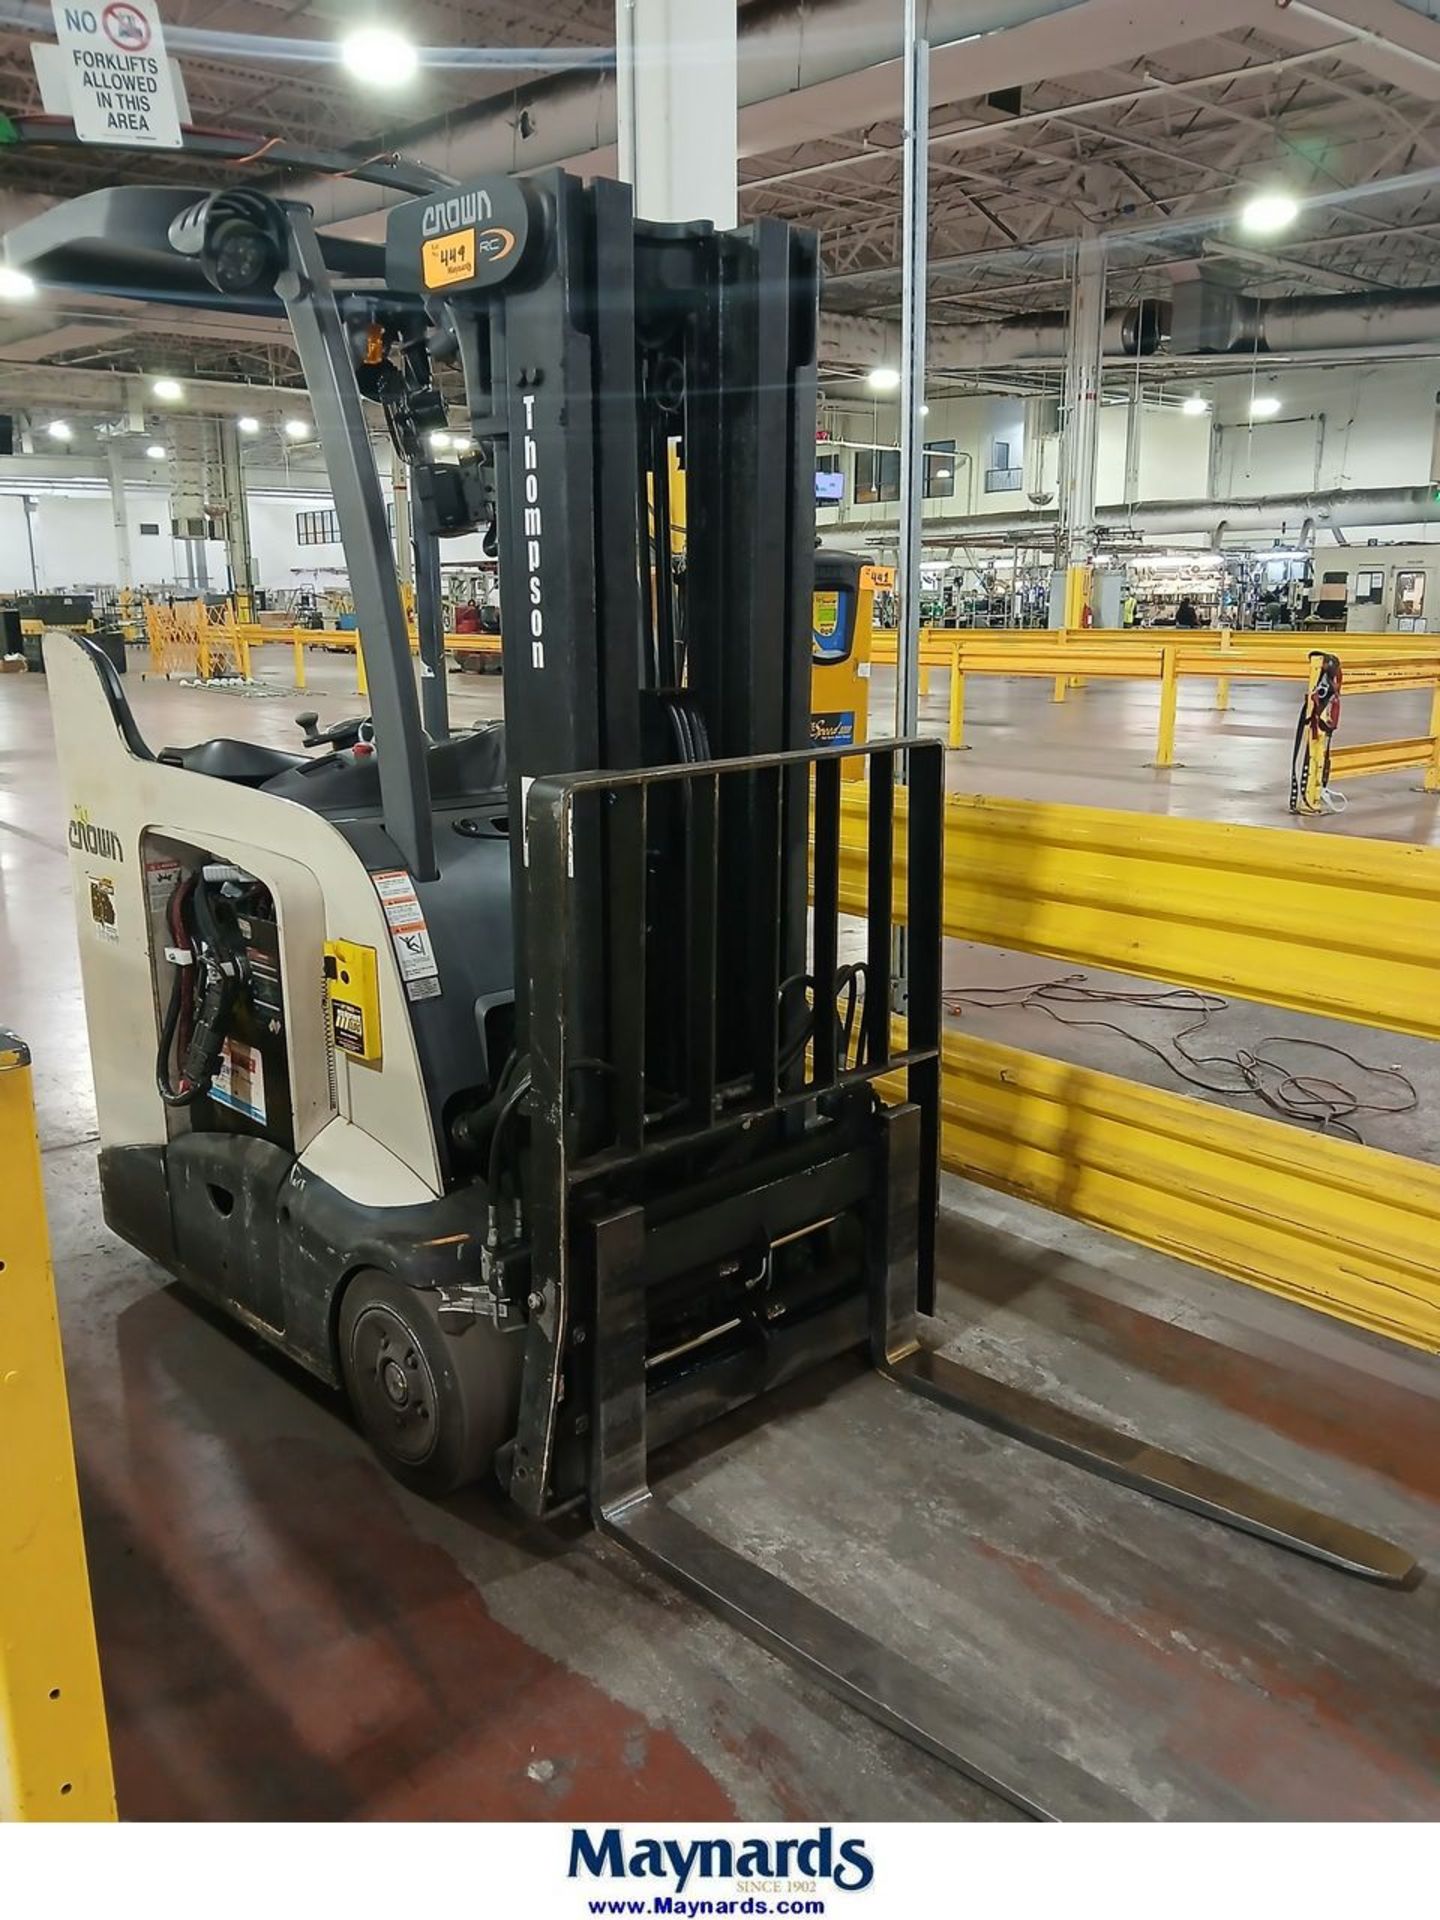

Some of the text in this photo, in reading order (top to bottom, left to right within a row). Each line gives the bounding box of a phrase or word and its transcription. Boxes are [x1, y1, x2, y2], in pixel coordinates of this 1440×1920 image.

[64, 8, 98, 34] NO
[72, 49, 159, 74] FORKLIFTS
[82, 70, 158, 94] ALLOWED
[96, 93, 151, 112] IN THIS
[107, 112, 150, 132] AREA
[422, 189, 492, 236] CROWN
[479, 238, 500, 253] RC
[522, 395, 545, 669] Thompson
[68, 820, 124, 862] CROWN
